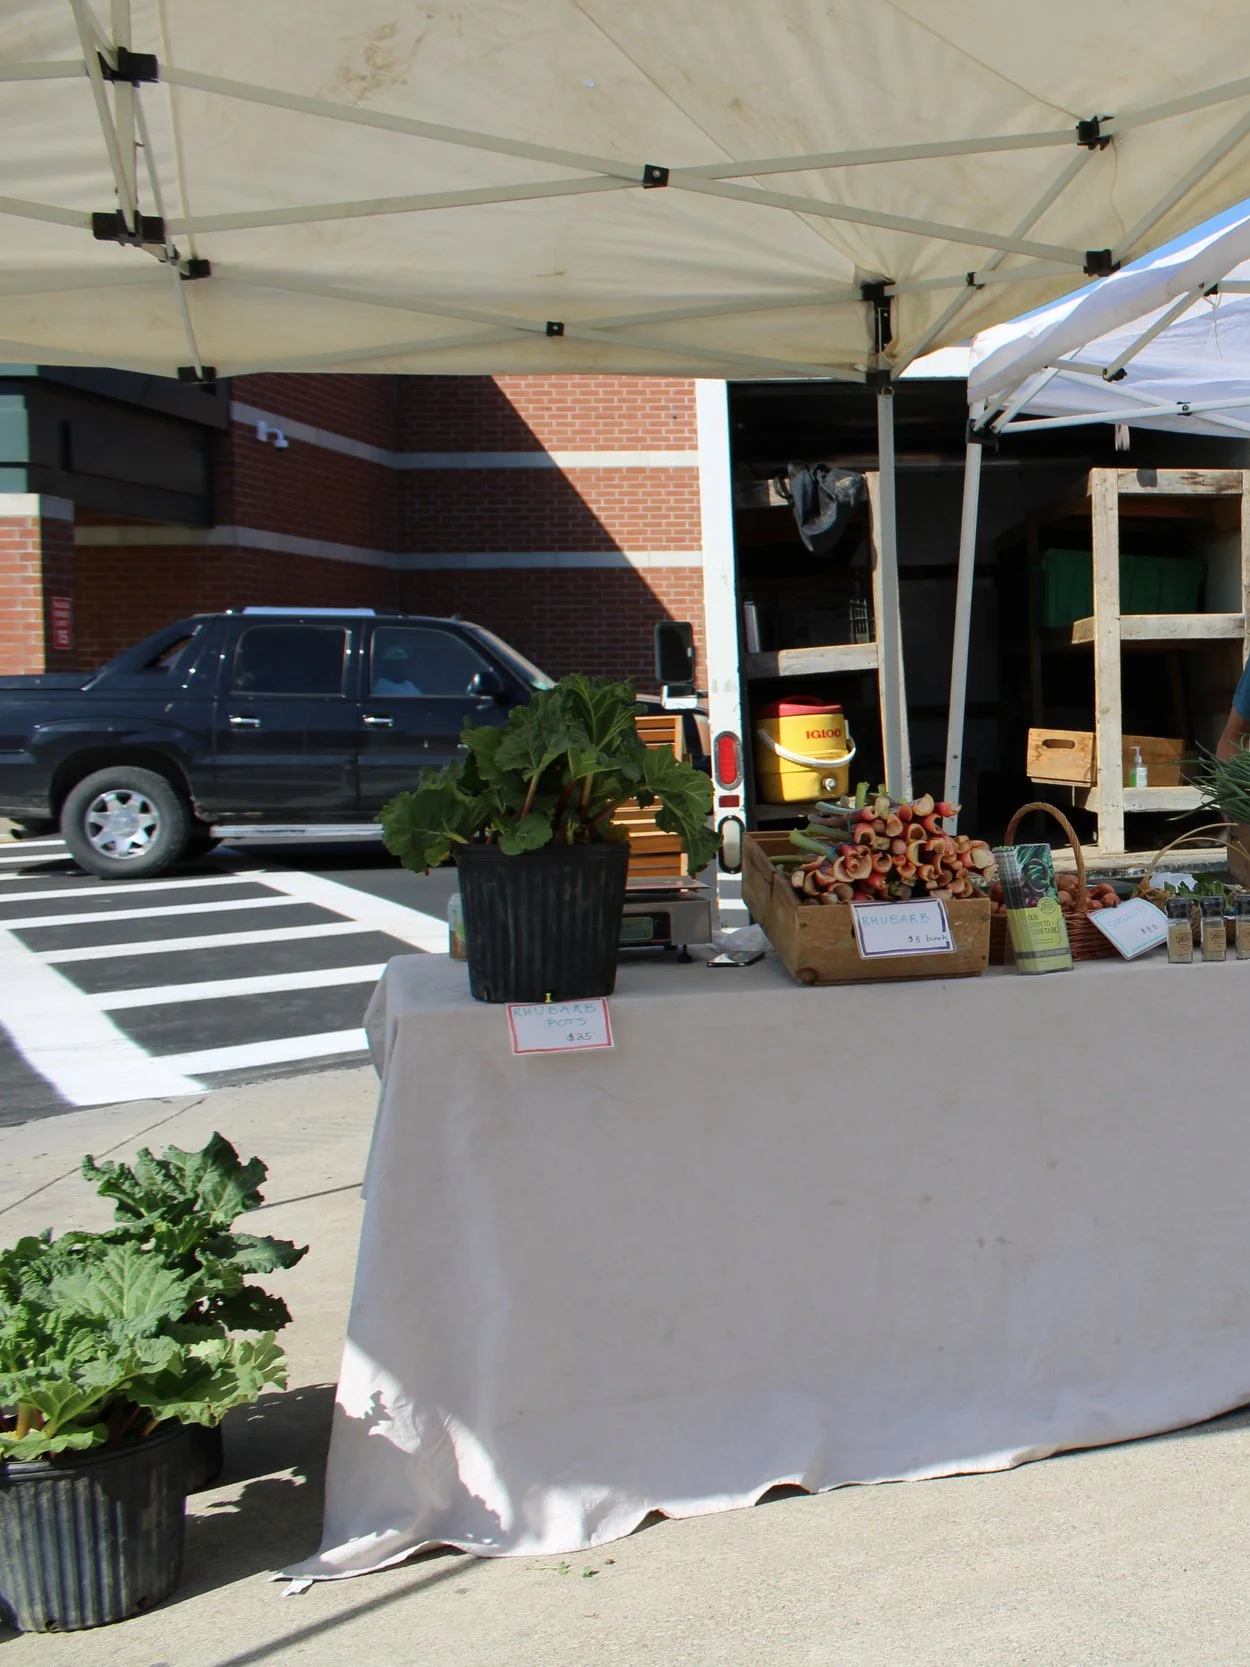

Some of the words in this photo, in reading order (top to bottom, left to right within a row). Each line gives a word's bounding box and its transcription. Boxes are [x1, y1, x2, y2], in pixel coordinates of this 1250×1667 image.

[806, 728, 842, 740] IGLOO
[861, 911, 931, 927] RHUBARB
[513, 1004, 597, 1018] RHUBARB
[546, 1018, 588, 1028] POTS
